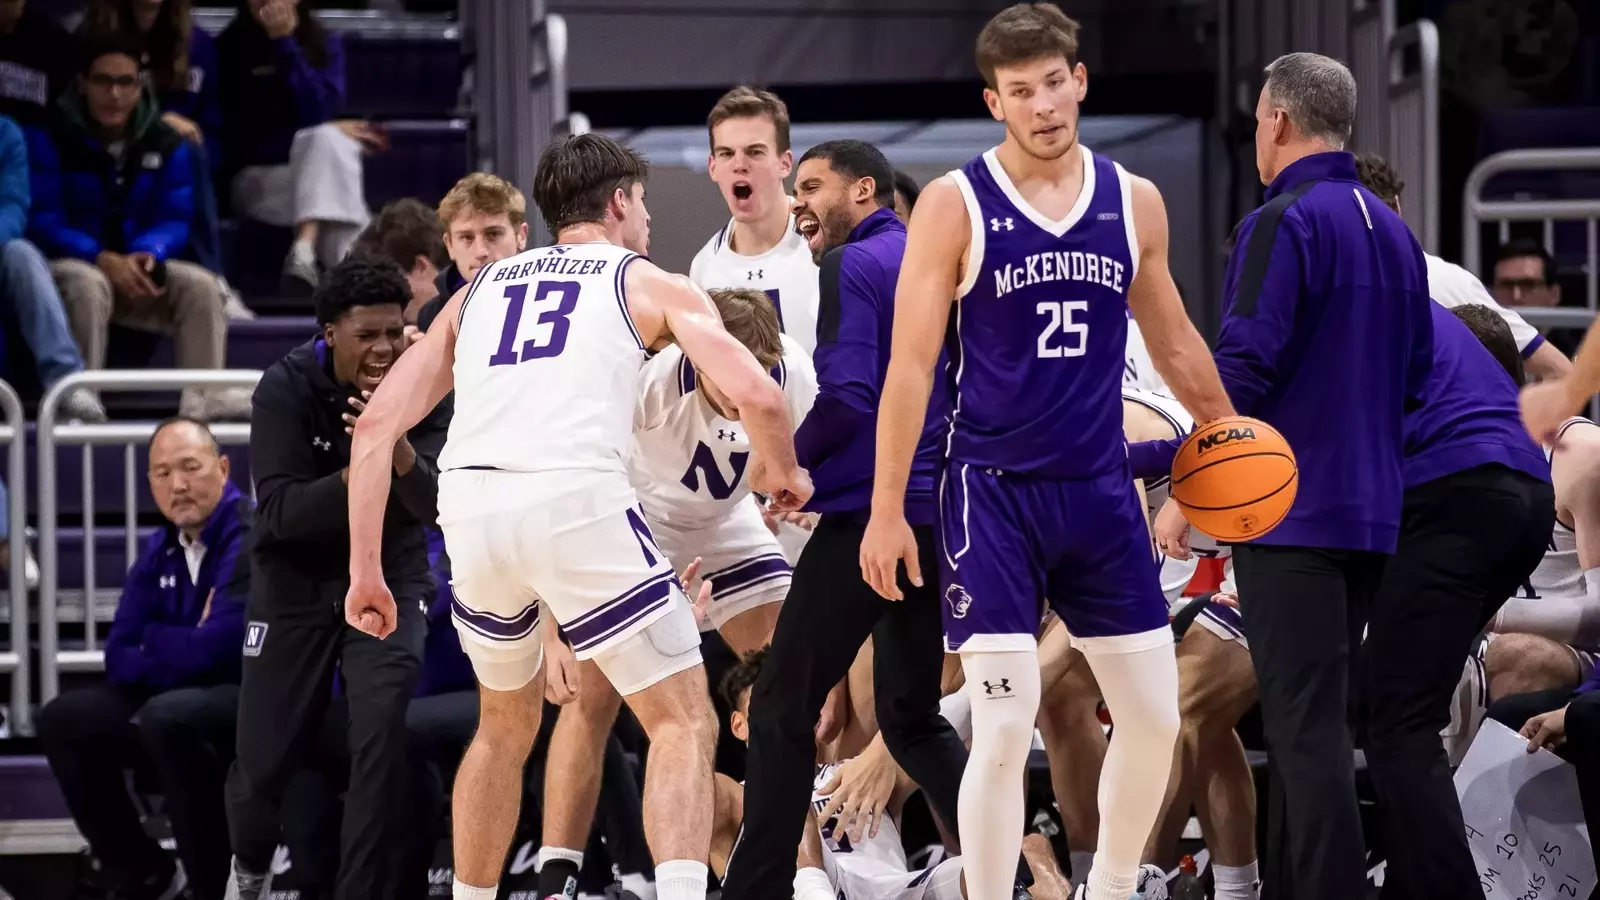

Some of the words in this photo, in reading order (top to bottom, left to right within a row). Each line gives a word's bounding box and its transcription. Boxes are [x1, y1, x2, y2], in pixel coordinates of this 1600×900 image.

[492, 257, 608, 282] BARNHIZER
[488, 280, 582, 367] 13
[1036, 300, 1089, 358] 25
[1197, 427, 1257, 454] NCAA
[247, 626, 260, 646] N
[1496, 833, 1518, 860] 10
[1539, 841, 1562, 867] 25
[1559, 874, 1580, 897] 21
